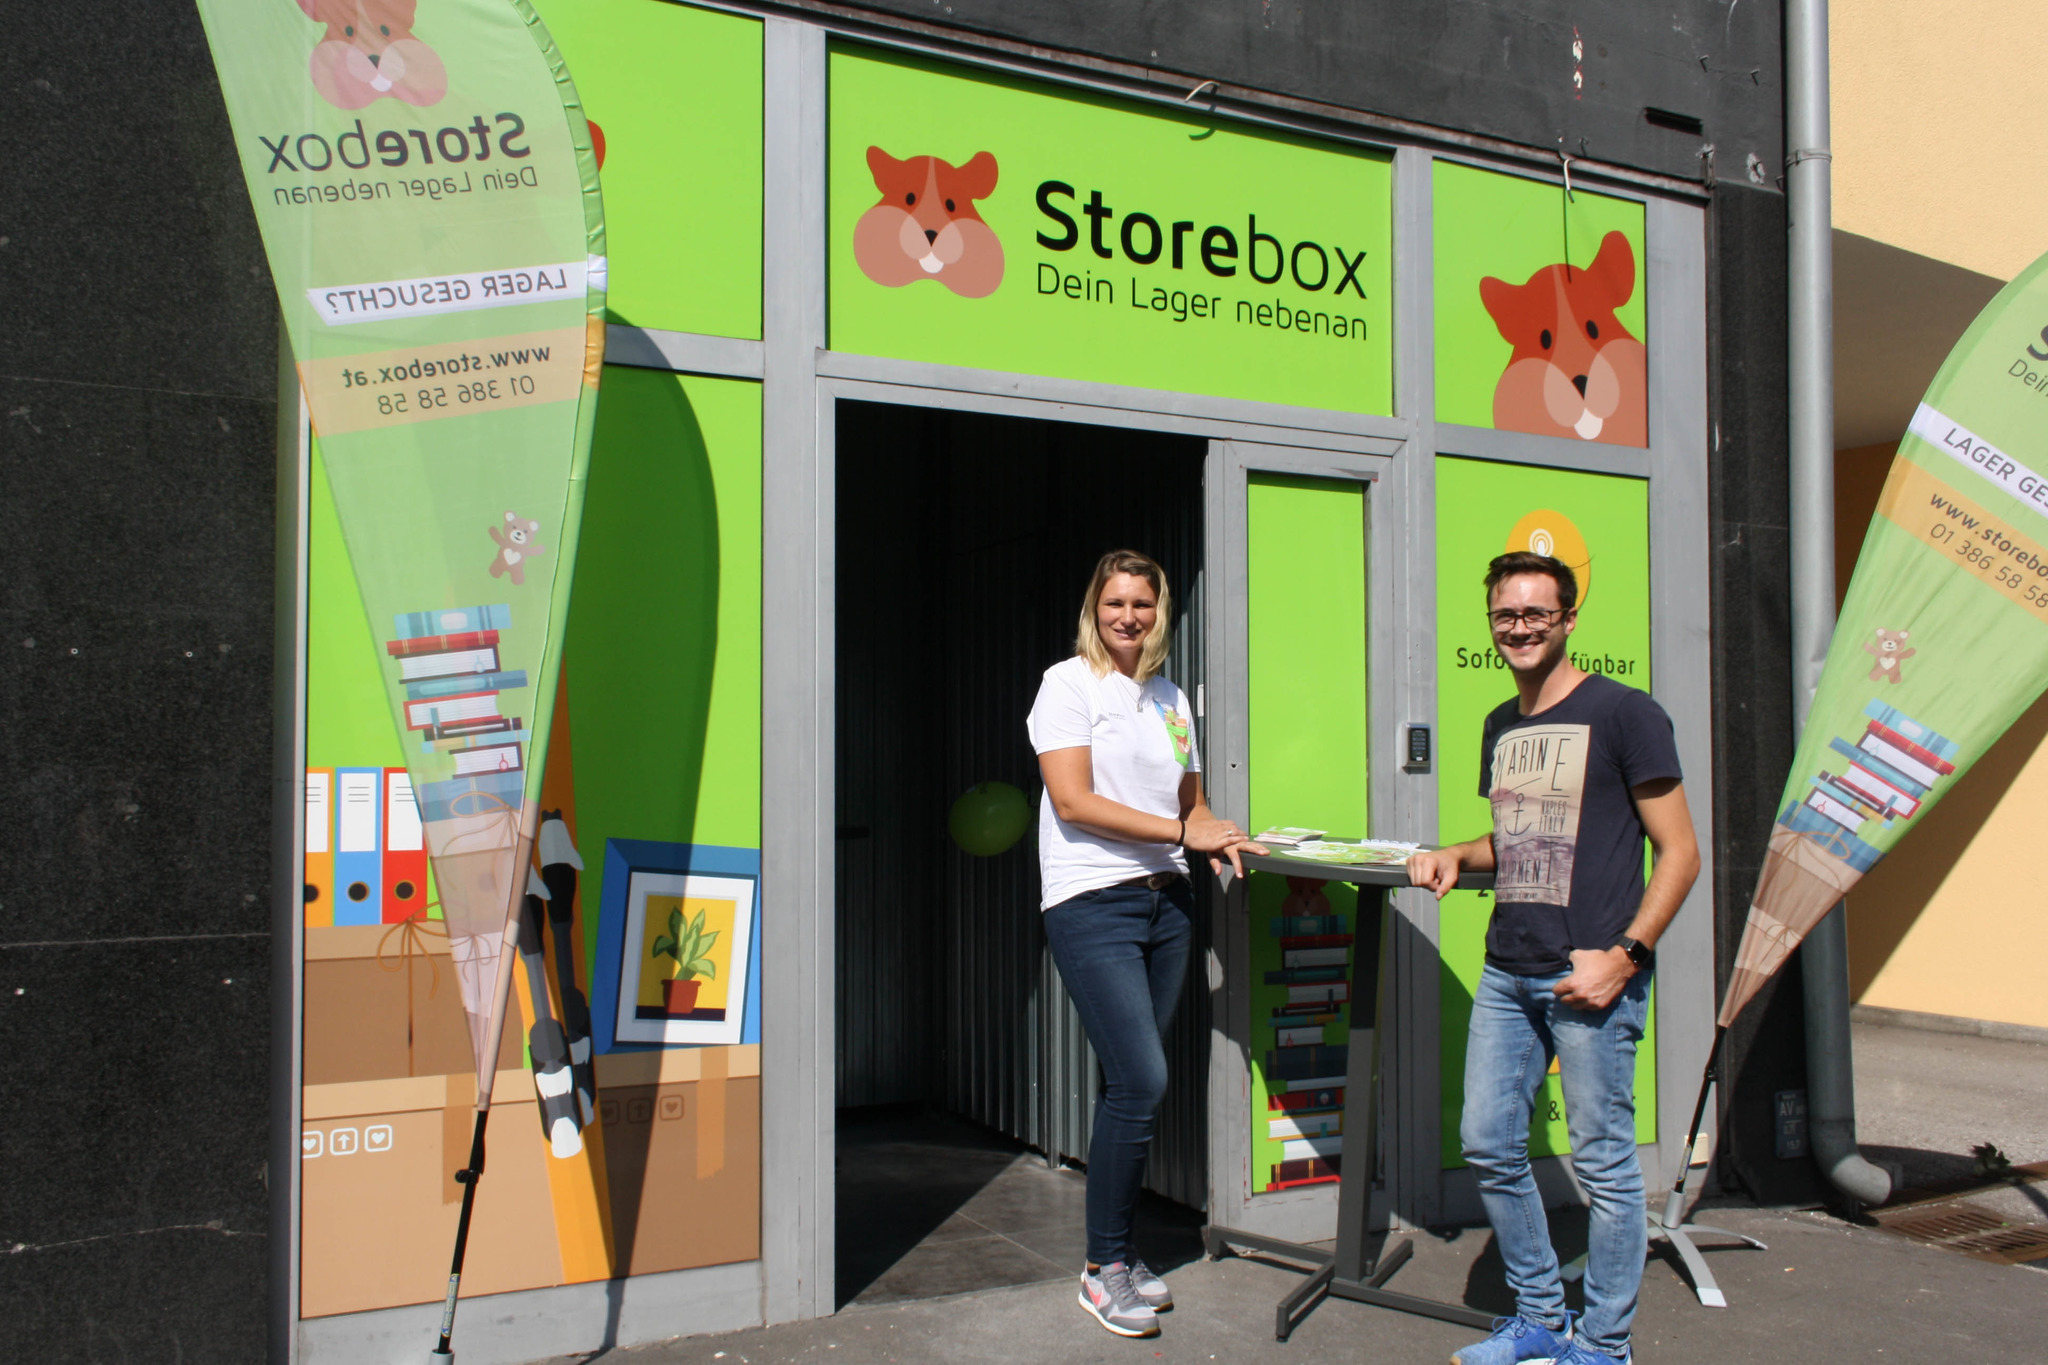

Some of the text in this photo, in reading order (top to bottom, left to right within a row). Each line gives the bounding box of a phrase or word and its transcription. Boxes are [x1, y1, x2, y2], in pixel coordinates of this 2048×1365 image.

[1035, 180, 1368, 300] Storebox
[1037, 262, 1367, 341] Dein Lager nebenan
[1943, 427, 2016, 481] LAGER
[1930, 493, 2048, 581] www.storebo
[1930, 523, 2048, 609] 01 386 58 58
[1456, 647, 1636, 675] Sofo fügbar
[1539, 815, 1566, 833] ITALY
